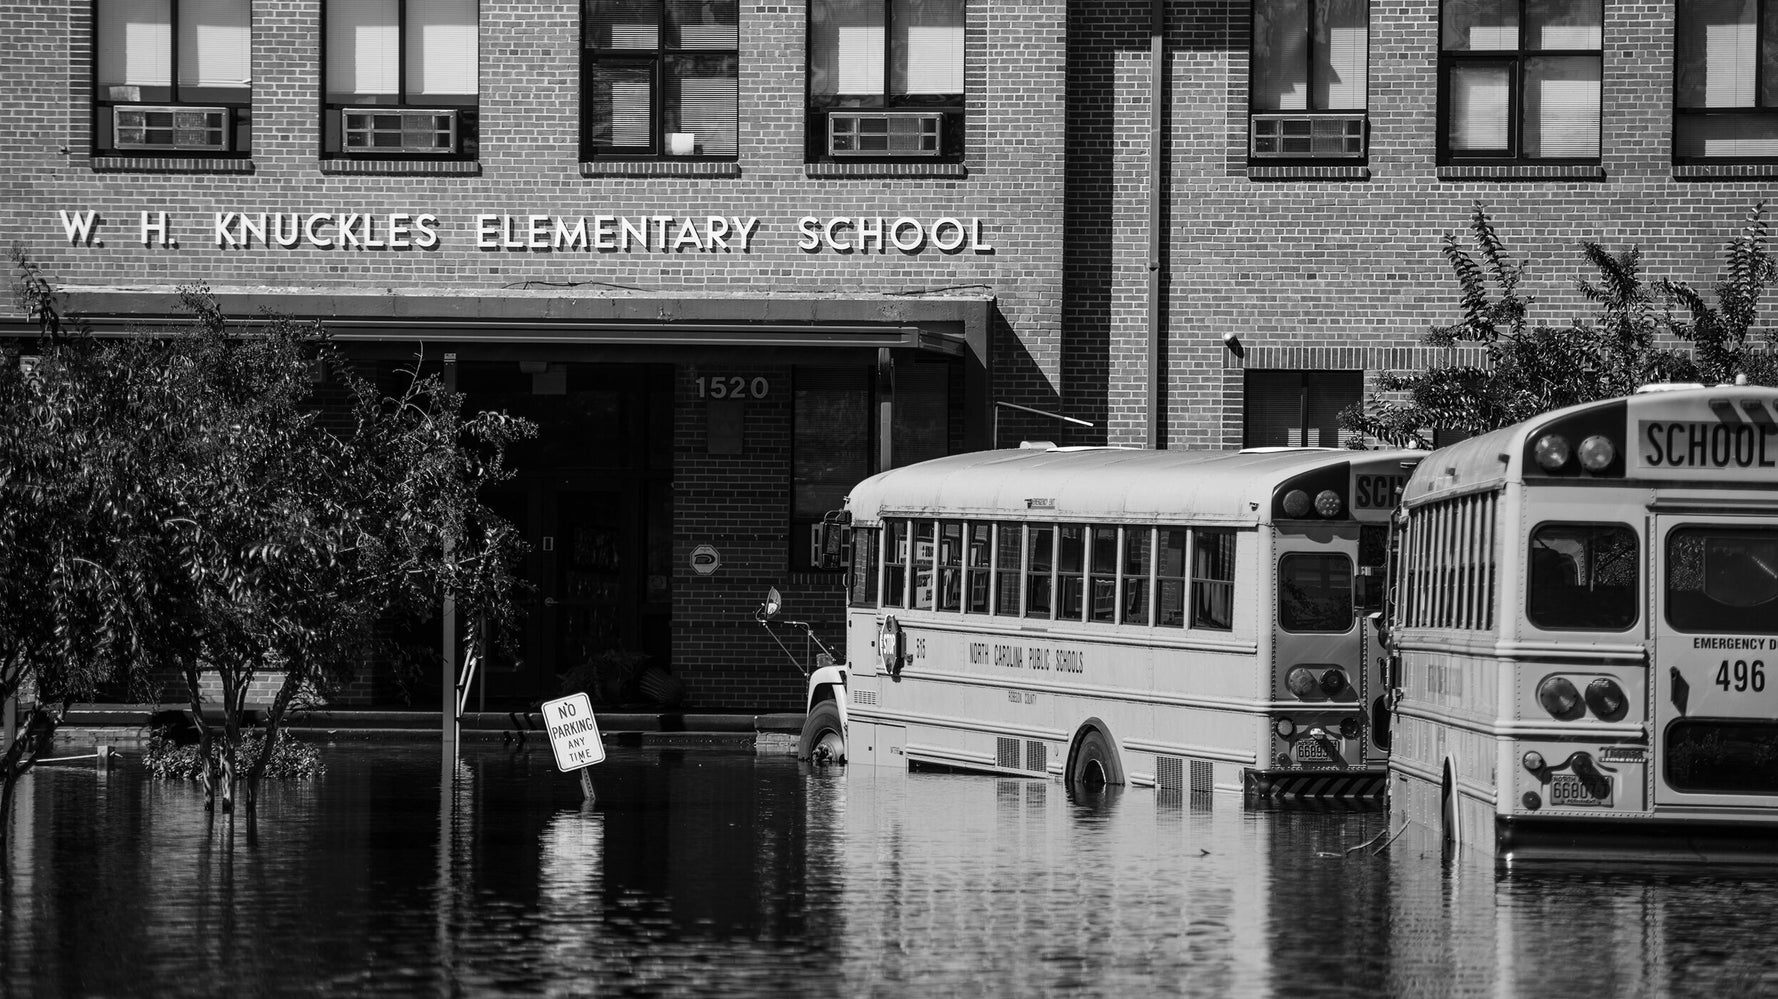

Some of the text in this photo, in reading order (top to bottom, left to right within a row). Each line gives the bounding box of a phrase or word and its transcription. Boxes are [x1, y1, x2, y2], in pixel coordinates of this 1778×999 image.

[60, 209, 991, 251] W. H. KNUCKLES ELEMENTARY SCHOOL
[696, 376, 769, 399] 1520
[1646, 422, 1776, 467] SCHOOL
[1356, 474, 1404, 508] SCH
[1693, 637, 1778, 650] EMERGENCY D
[969, 642, 1084, 674] NORTH CAROLINA PUBLIC SCHOOLS
[1715, 659, 1766, 693] 496
[558, 703, 576, 720] NO
[551, 717, 593, 740] PARKING
[568, 736, 585, 750] ANY
[569, 748, 592, 762] TIME
